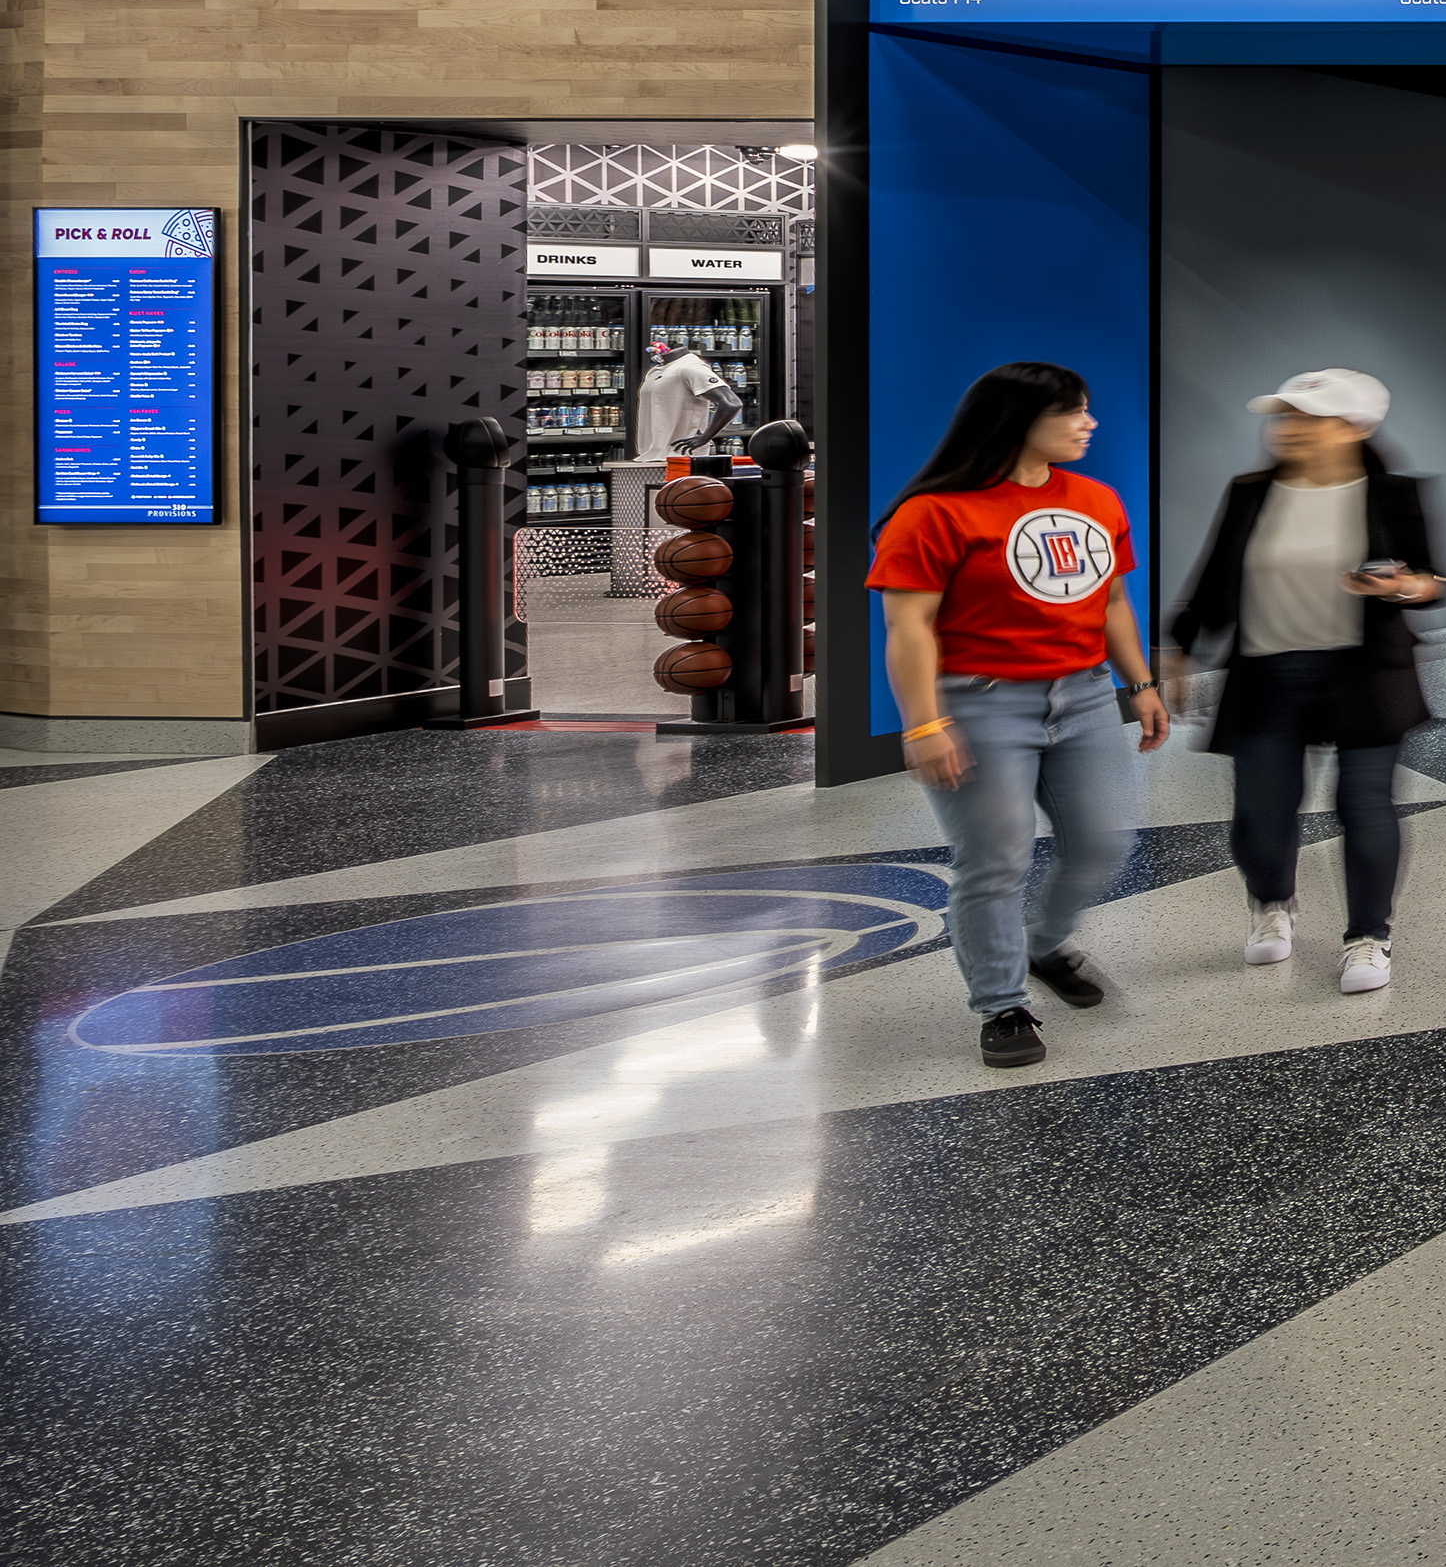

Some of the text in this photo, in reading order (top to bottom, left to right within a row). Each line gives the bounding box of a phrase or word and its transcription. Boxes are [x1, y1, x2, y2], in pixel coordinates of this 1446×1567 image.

[55, 228, 151, 240] PICK & ROLL
[537, 254, 597, 265] DRINKS
[691, 258, 742, 268] WATER
